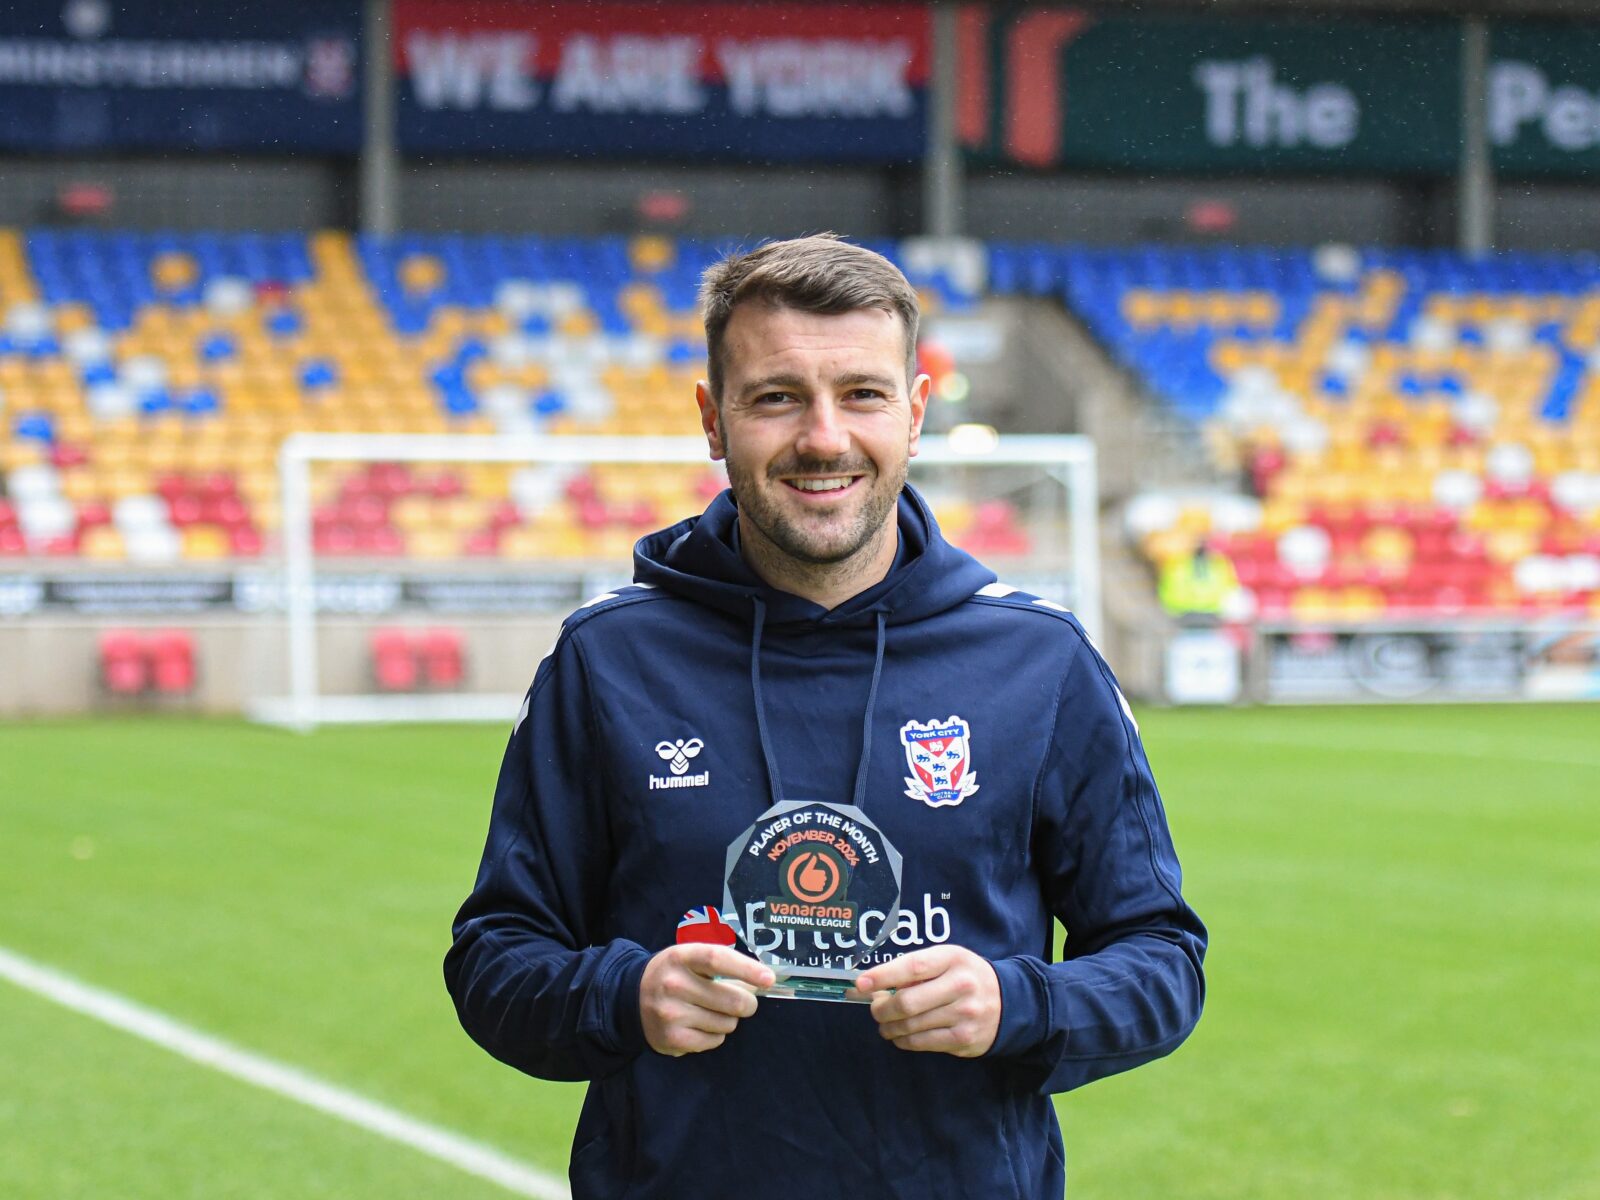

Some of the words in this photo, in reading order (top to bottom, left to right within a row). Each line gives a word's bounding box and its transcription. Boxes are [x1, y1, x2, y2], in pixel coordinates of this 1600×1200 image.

[405, 30, 538, 110] WE
[550, 33, 703, 113] ARE
[715, 37, 912, 118] YORK
[1197, 57, 1357, 148] The
[1488, 60, 1600, 151] Pe
[910, 731, 937, 739] YORK
[938, 728, 960, 737] CITY
[649, 771, 709, 790] hummel
[749, 817, 792, 857] PLAYER
[792, 812, 812, 824] OF
[815, 812, 842, 828] THE
[841, 821, 880, 864] MONTH
[767, 830, 835, 861] NOVEMBER
[834, 838, 860, 867] 2024
[770, 902, 853, 919] vanarama
[770, 915, 815, 926] NATIONAL
[816, 918, 851, 928] LEAGUE
